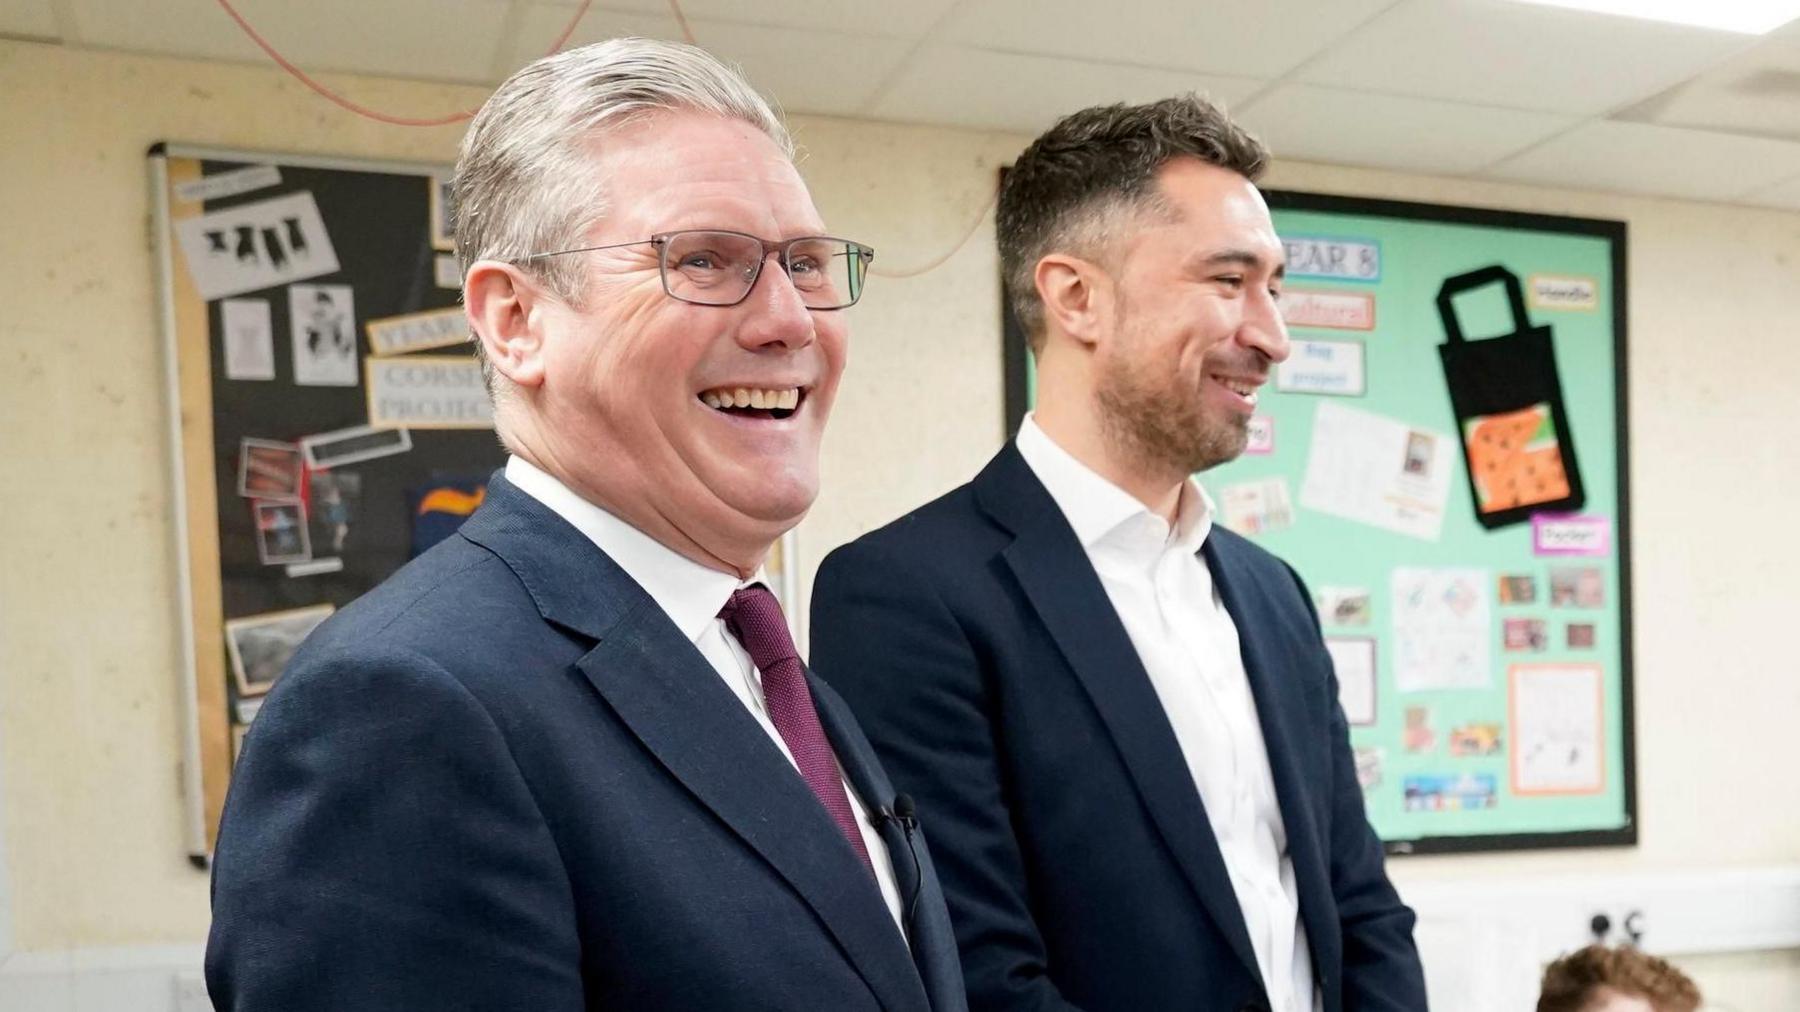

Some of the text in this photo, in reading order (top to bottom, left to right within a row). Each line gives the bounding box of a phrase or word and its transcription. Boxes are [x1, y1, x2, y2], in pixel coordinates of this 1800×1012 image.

[1285, 243, 1348, 274] EAR
[378, 314, 457, 347] YEAR
[383, 365, 483, 388] CORSE
[378, 396, 490, 421] PROJEC
